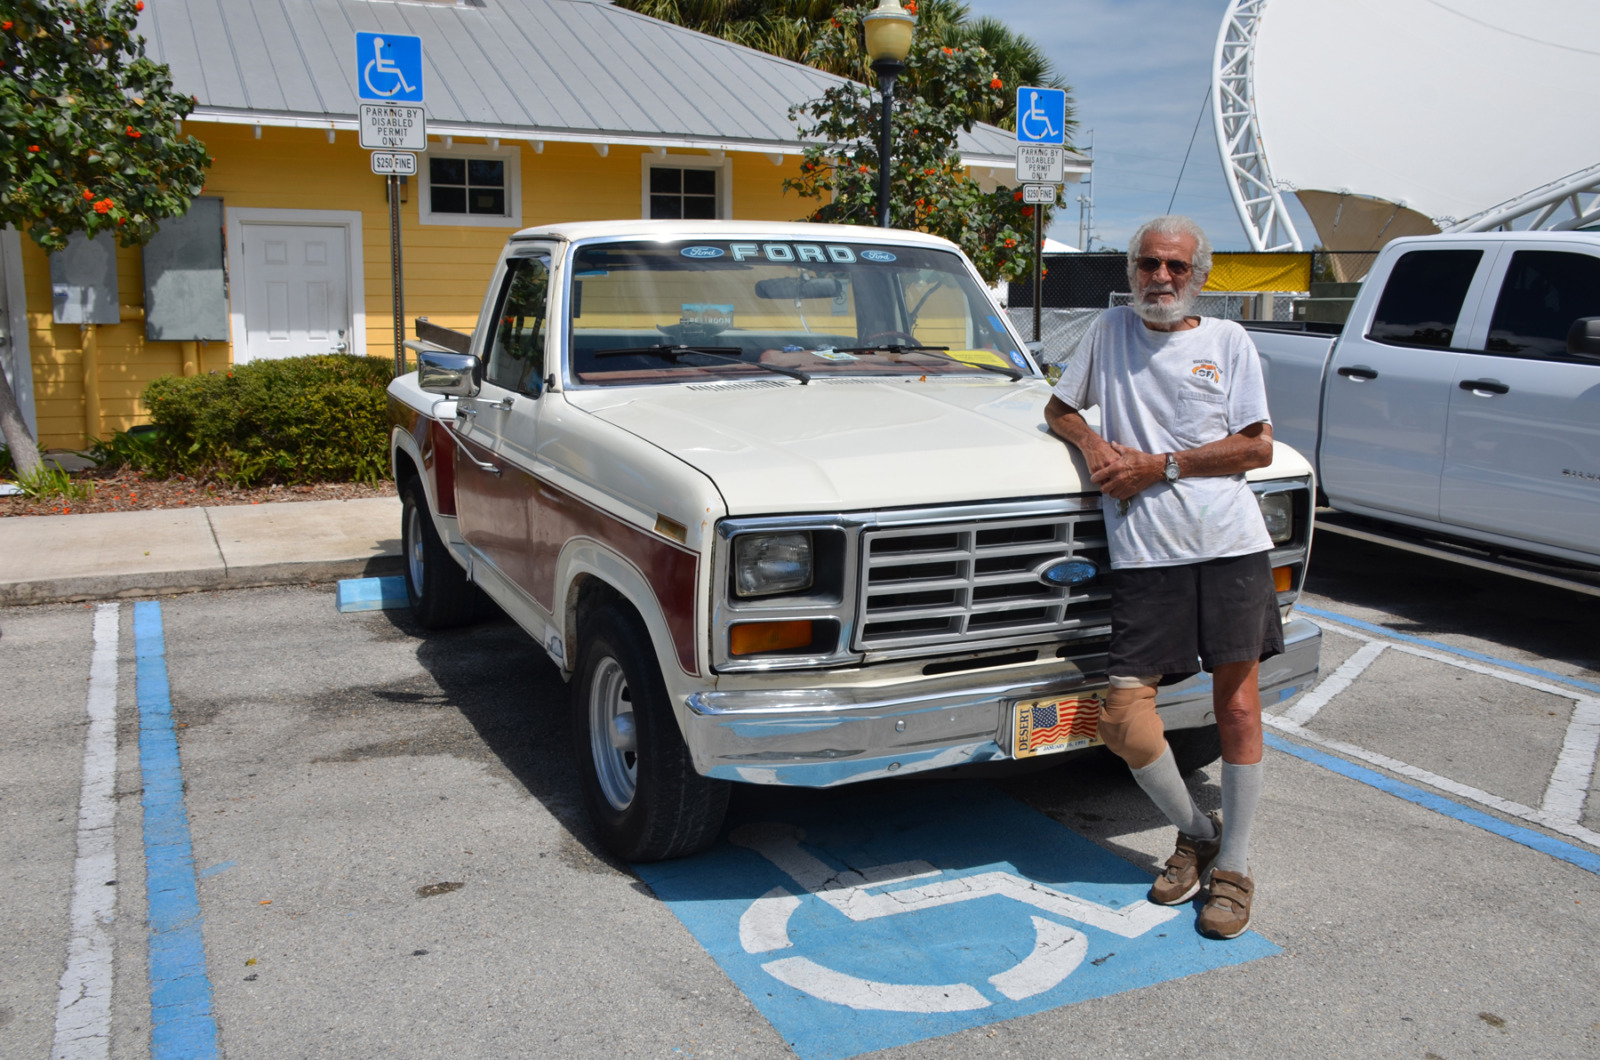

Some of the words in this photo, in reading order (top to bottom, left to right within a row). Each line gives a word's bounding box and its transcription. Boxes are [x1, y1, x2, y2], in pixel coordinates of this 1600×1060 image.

[366, 107, 403, 118] PARKING
[407, 109, 418, 118] BY
[371, 118, 413, 128] DISABLED
[377, 127, 408, 137] PERMIT
[382, 136, 404, 146] ONLY
[1021, 148, 1048, 157] PARKING
[1050, 149, 1059, 157] BY
[376, 157, 393, 168] $250
[395, 157, 411, 169] FINE
[1025, 156, 1055, 164] DISABLED
[1040, 189, 1052, 198] FINE
[689, 247, 717, 257] Ford
[729, 242, 857, 263] FORD
[1018, 708, 1030, 752] DESERT
